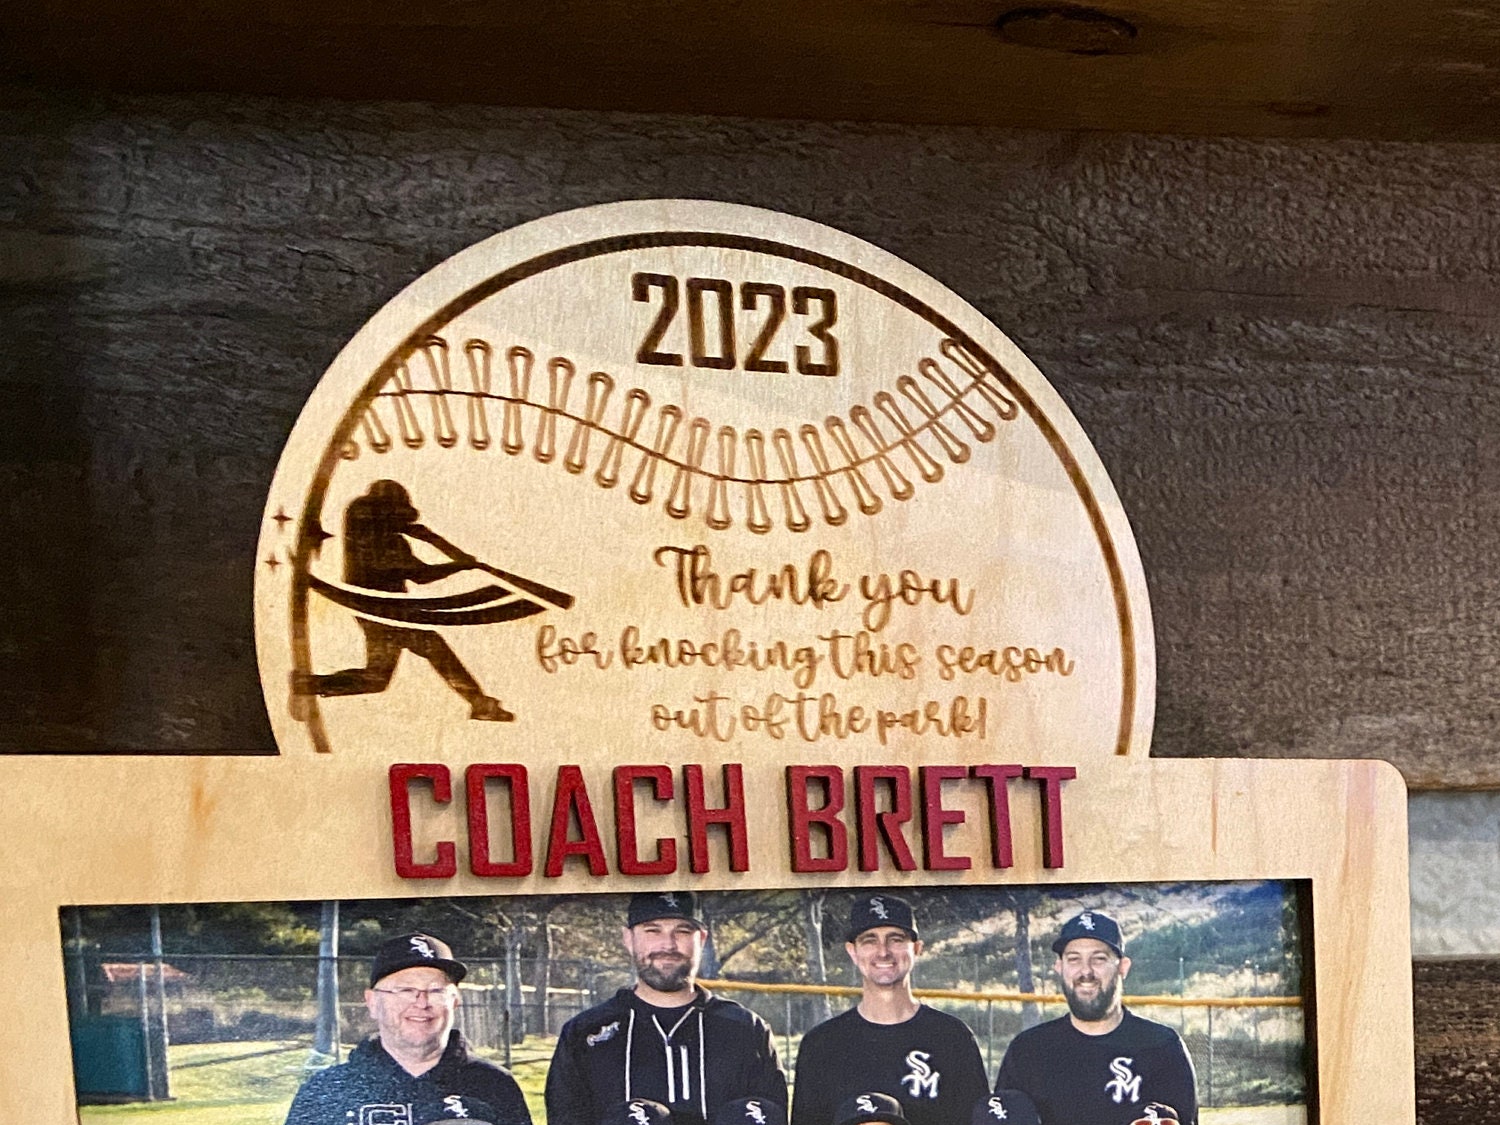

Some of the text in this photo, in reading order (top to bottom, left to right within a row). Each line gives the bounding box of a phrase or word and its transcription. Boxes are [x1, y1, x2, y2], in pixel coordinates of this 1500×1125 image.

[631, 272, 839, 377] 2023
[654, 545, 977, 631] Thank you
[536, 624, 1075, 689] for knocking this season
[650, 692, 988, 745] out of the park!
[388, 762, 1077, 879] COACH BRETT
